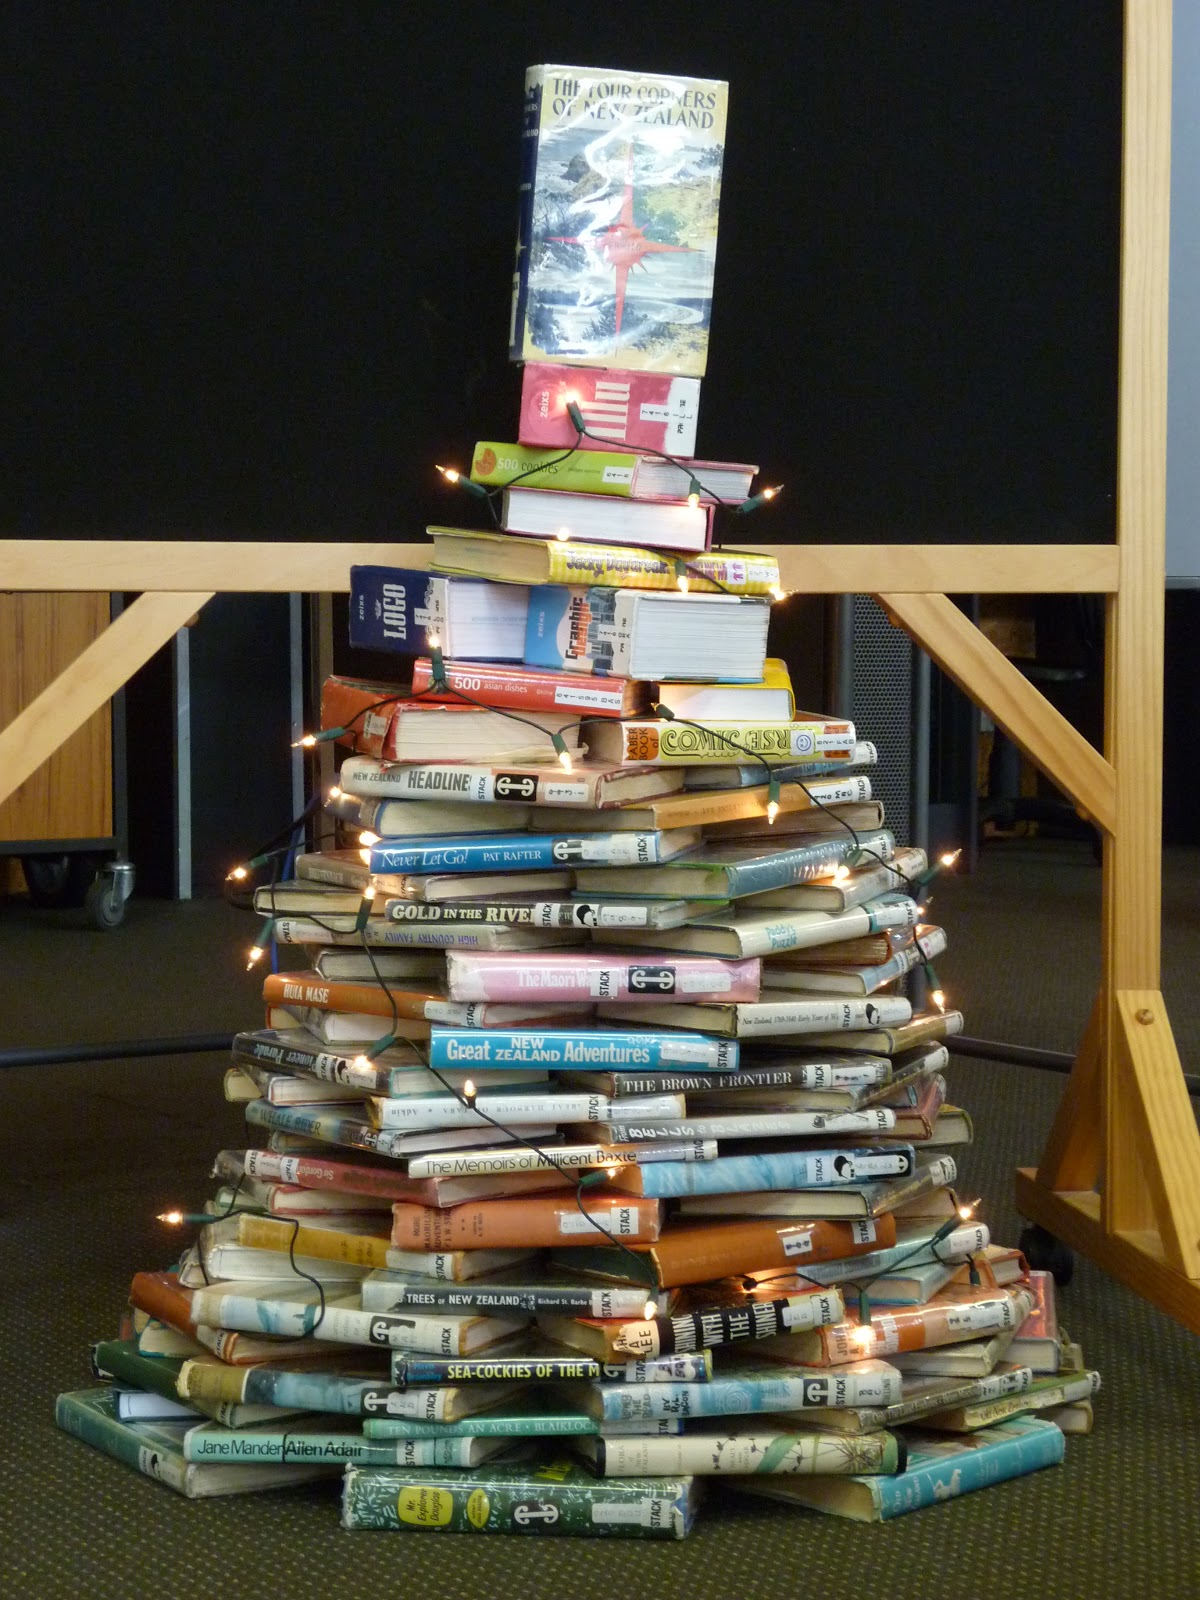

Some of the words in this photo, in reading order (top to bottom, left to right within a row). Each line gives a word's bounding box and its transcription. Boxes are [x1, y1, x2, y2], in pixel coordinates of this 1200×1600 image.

[538, 390, 550, 418] zeixs
[497, 457, 519, 470] 500
[383, 583, 407, 640] LOGO
[454, 677, 481, 691] 500
[483, 684, 503, 692] asian
[504, 683, 528, 693] dishes
[627, 728, 638, 761] FABER
[639, 727, 650, 761] BOOK
[353, 772, 368, 781] NEW
[369, 772, 402, 783] ZEALAND
[478, 776, 487, 800] STACK
[381, 852, 419, 868] Never
[421, 851, 442, 866] Let
[443, 850, 469, 865] Go!
[483, 852, 500, 862] PAT
[503, 850, 542, 861] RAFTER
[638, 836, 648, 862] STACK
[392, 904, 441, 921] GOLD
[443, 908, 457, 919] IN
[459, 908, 483, 920] THE
[542, 903, 552, 927] STACK
[282, 922, 292, 943] STACK
[384, 932, 414, 944] FAMILY
[418, 933, 455, 945] COUNTRY
[458, 934, 478, 946] HIGH
[283, 984, 303, 1000] HUIA
[305, 987, 330, 1004] MASE
[599, 970, 611, 996] STACK
[466, 1002, 476, 1026] STACK
[842, 1003, 851, 1027] STACK
[447, 1040, 491, 1060] Great
[495, 1049, 561, 1062] ZEALAND
[563, 1041, 650, 1063] Adventures
[511, 1037, 545, 1049] NEW
[717, 1042, 729, 1068] STACK
[623, 1080, 656, 1092] THE
[661, 1078, 713, 1091] BROWN
[719, 1072, 793, 1088] FRONTIER
[588, 1095, 599, 1121] STACK
[320, 1170, 334, 1180] Sir
[426, 1161, 452, 1175] The
[454, 1158, 515, 1173] Memoirs
[519, 1154, 533, 1168] of
[424, 1207, 433, 1248] MAORILAN
[620, 1208, 630, 1233] STACK
[406, 1293, 435, 1304] TREES
[449, 1294, 472, 1304] NEW
[476, 1296, 519, 1305] ZEALAND
[601, 1291, 611, 1317] STACK
[752, 1302, 776, 1340] SHINER
[820, 1300, 831, 1323] STACK
[702, 1313, 724, 1347] WITH
[730, 1312, 749, 1340] THE
[443, 1327, 451, 1354] STACK
[447, 1366, 532, 1379] SEA-COCKIES
[536, 1366, 553, 1377] OF
[559, 1365, 584, 1377] THE
[836, 1379, 845, 1406] STACK
[427, 1392, 437, 1418] STACK
[469, 1423, 484, 1432] AN
[490, 1422, 521, 1432] ACRE
[198, 1440, 229, 1455] Jane
[231, 1440, 284, 1456] Mander
[286, 1440, 322, 1456] Allen
[326, 1442, 362, 1457] Adair
[406, 1440, 415, 1466] STACK
[408, 1500, 416, 1512] Mr.
[418, 1488, 429, 1522] Explorer
[431, 1491, 443, 1522] Douglas
[651, 1500, 661, 1526] STACK
